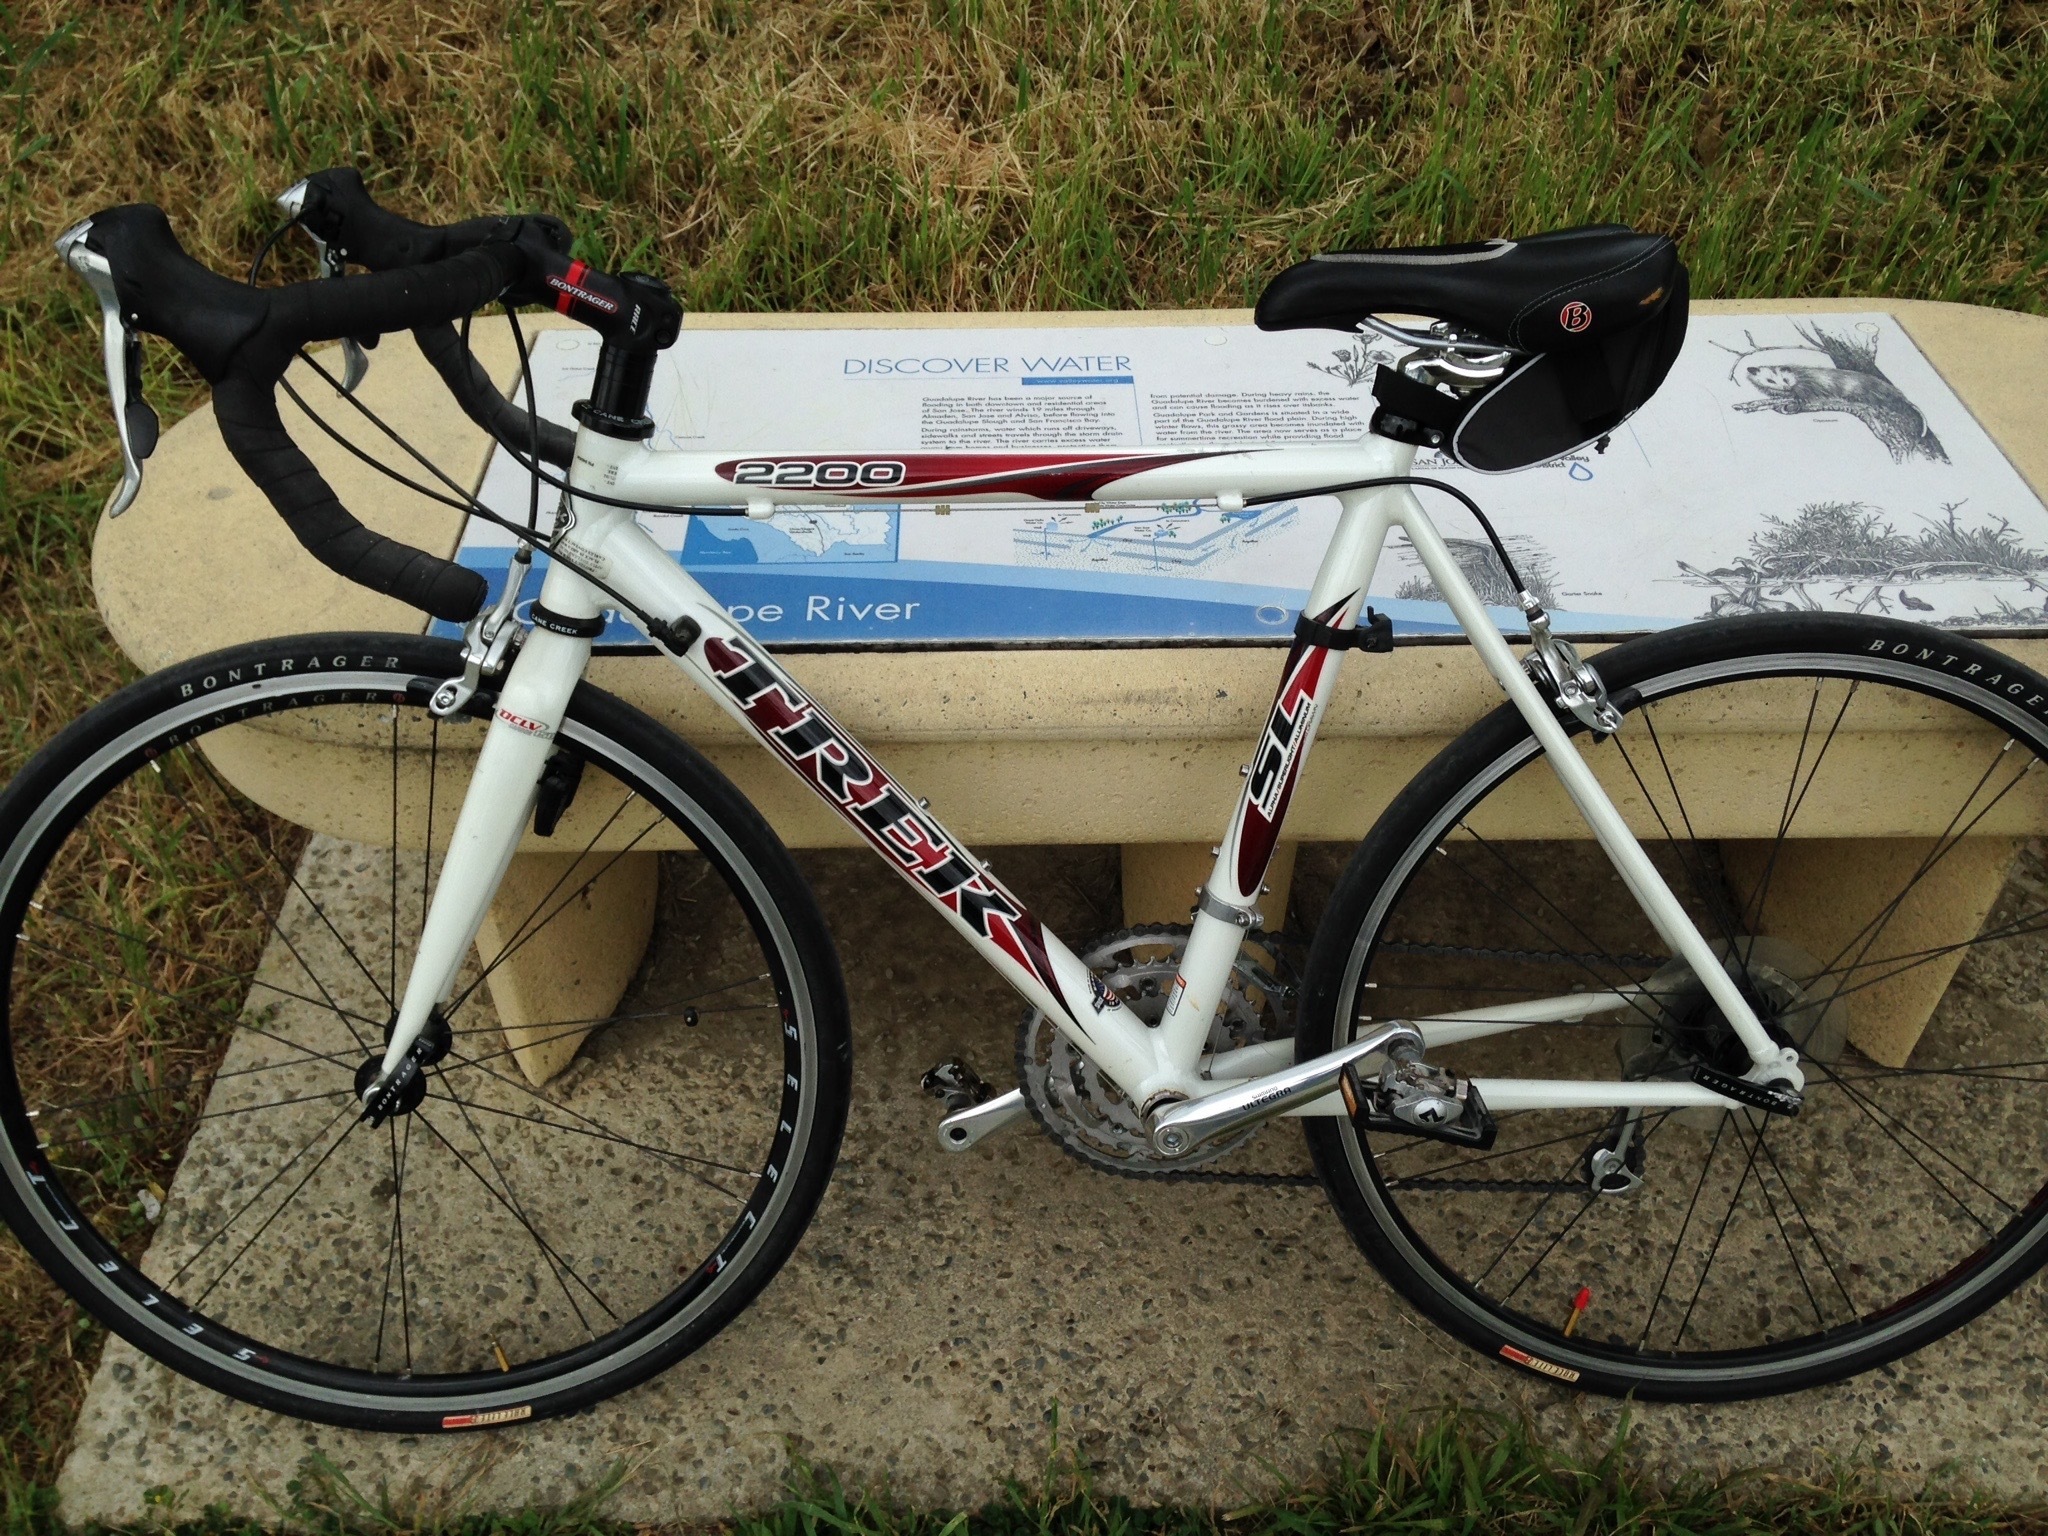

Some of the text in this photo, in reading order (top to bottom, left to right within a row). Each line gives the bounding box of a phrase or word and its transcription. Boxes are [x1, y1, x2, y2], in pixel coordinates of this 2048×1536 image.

[549, 278, 614, 311] BONTRAGER
[1565, 305, 1588, 327] B
[843, 356, 1132, 374] DISCOVER WATER
[593, 410, 624, 422] CANE
[732, 460, 907, 488] 2200
[806, 595, 920, 621] River
[532, 613, 578, 635] CANE CREEK
[180, 656, 399, 698] BONTRAGER
[1868, 639, 2048, 715] BONTRAGE
[169, 692, 376, 744] BONTRAGER
[500, 709, 542, 730] OCLV
[1250, 690, 1309, 816] SL
[713, 635, 1022, 940] TREK
[377, 1047, 423, 1111] BONTRAGER
[1702, 1074, 1778, 1106] BONTRAGER
[1242, 1087, 1292, 1110] ULTEGRA
